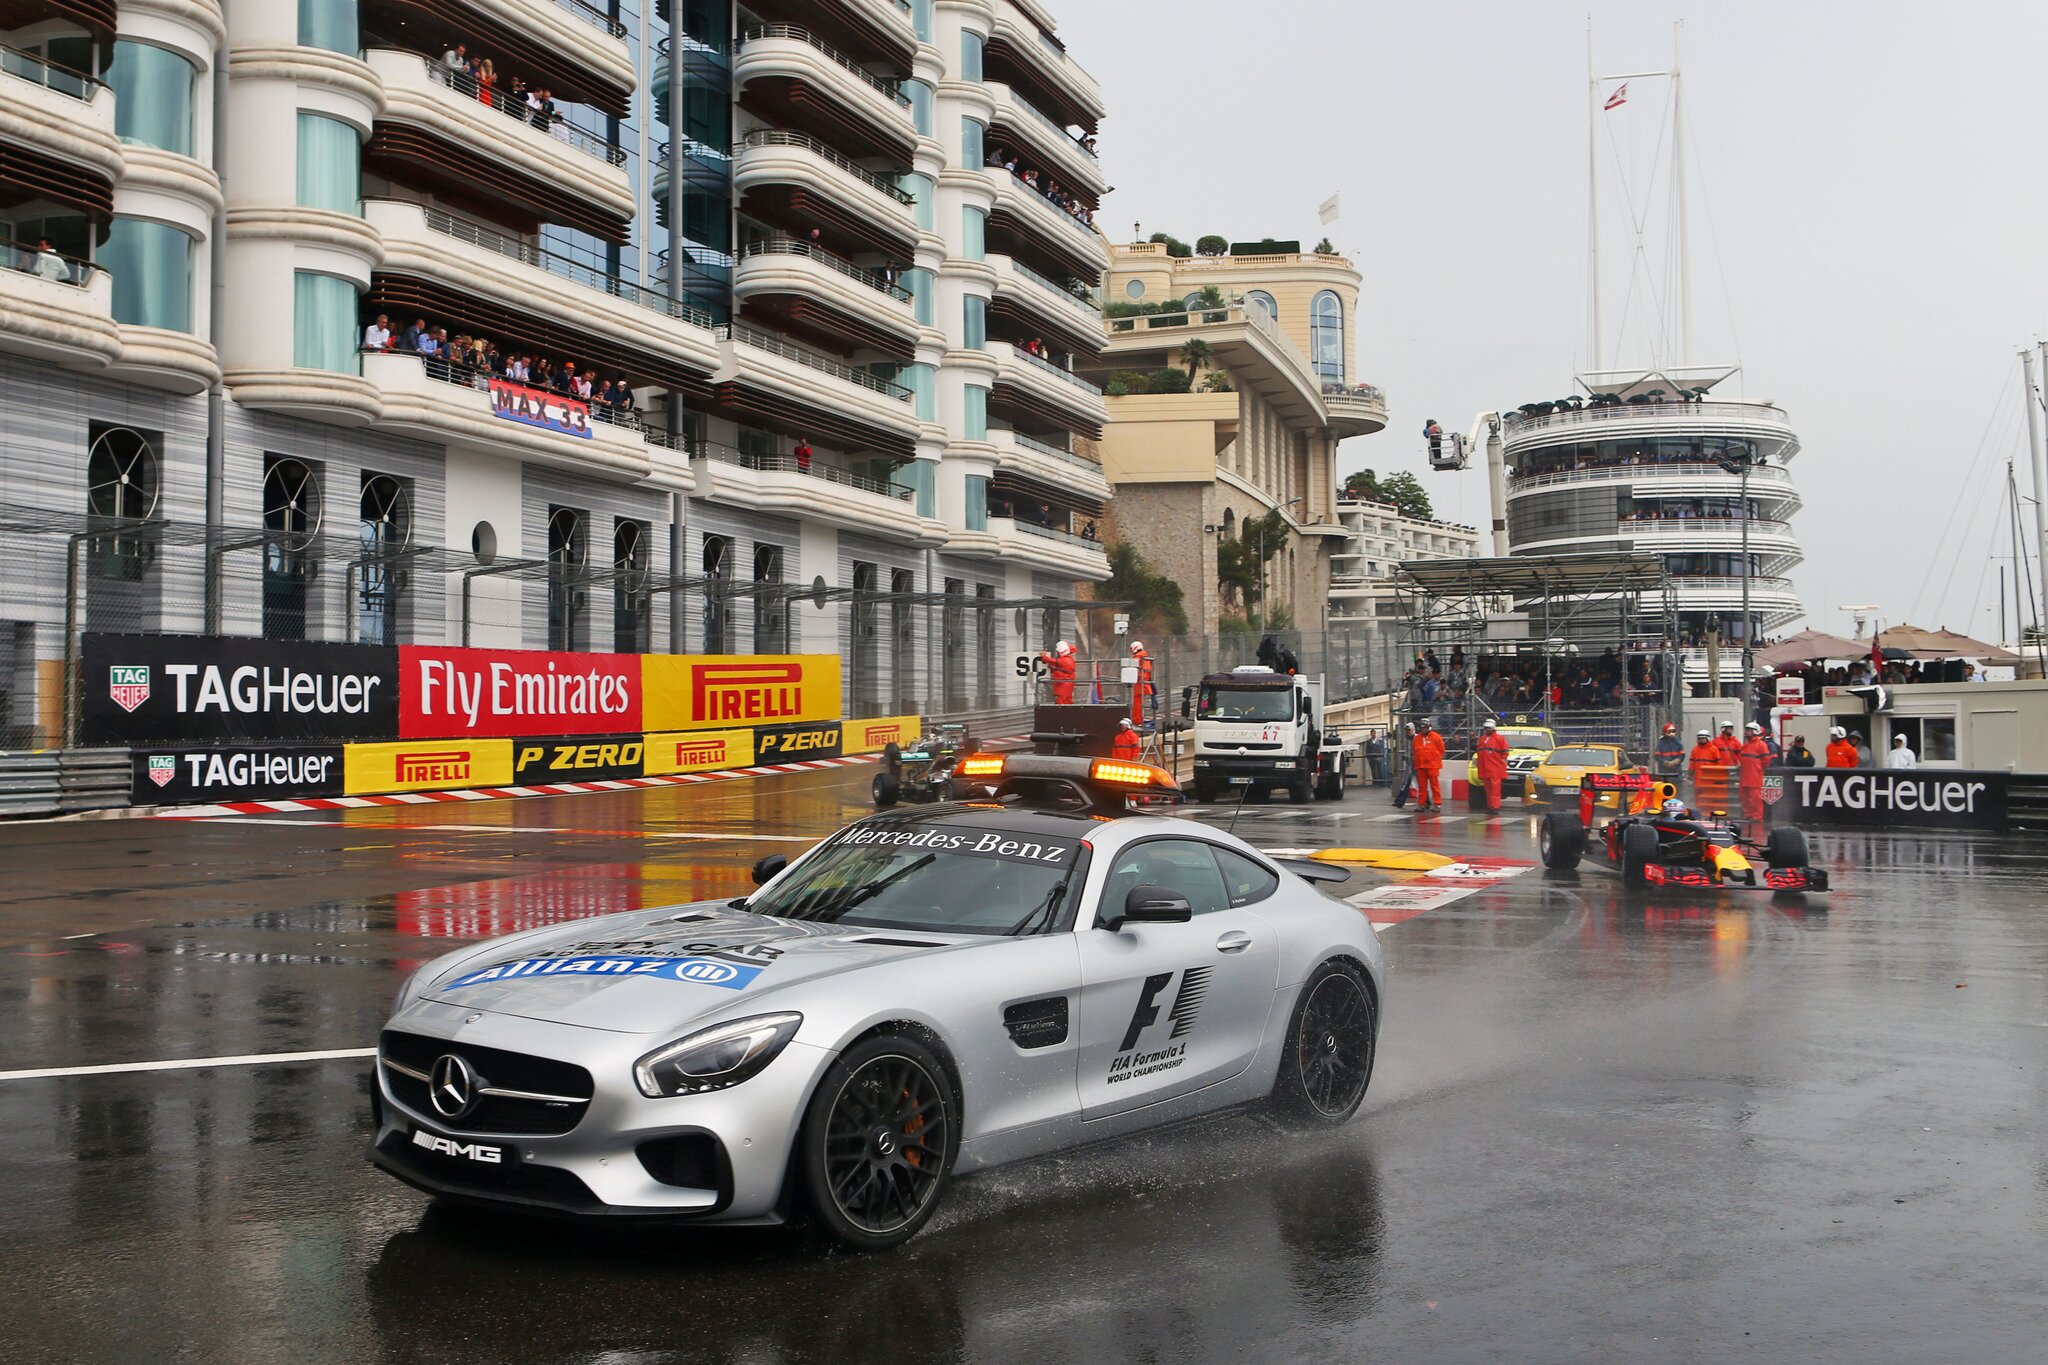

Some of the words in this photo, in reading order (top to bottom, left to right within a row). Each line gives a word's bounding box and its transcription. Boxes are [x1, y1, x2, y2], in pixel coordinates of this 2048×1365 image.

[497, 386, 549, 423] MAX
[559, 402, 587, 433] 33
[114, 668, 146, 683] TAG
[1016, 656, 1047, 677] SC
[112, 686, 149, 709] HEUER
[419, 659, 482, 727] Fly
[489, 661, 629, 715] Emirates
[692, 663, 803, 721] PIRELLI
[759, 735, 776, 754] P
[779, 730, 839, 752] ZERO
[865, 724, 900, 747] PIRELLI
[150, 758, 173, 768] TAG
[516, 747, 544, 772] P
[549, 743, 644, 770] ZERO
[676, 740, 726, 766] PIRELLI
[395, 751, 471, 782] PIRELLI
[834, 827, 1067, 863] Mercedes-Benz
[682, 943, 785, 960] CAR
[461, 958, 670, 985] Allianz
[1118, 965, 1216, 1053] F1
[1110, 1055, 1132, 1073] FIA
[1132, 1046, 1179, 1067] Formula
[1179, 1042, 1187, 1055] 1
[1107, 1071, 1132, 1085] WORLD
